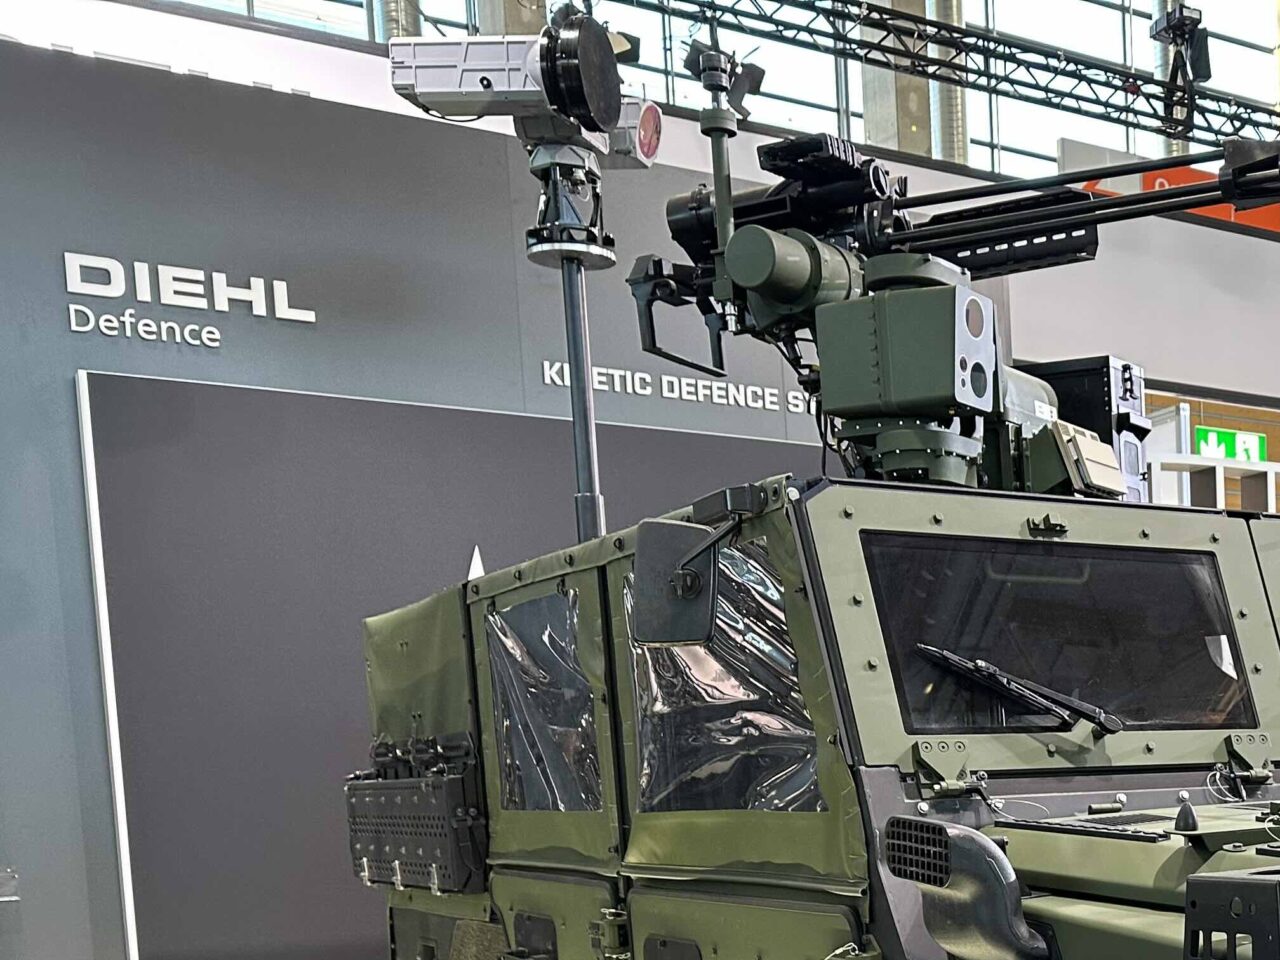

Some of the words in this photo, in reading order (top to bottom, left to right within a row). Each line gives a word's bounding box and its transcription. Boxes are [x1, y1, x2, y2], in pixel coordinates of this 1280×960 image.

[64, 251, 316, 323] DIEHL
[68, 303, 222, 348] Defence
[542, 360, 652, 396] KIETIC
[661, 375, 780, 411] DEFENCE
